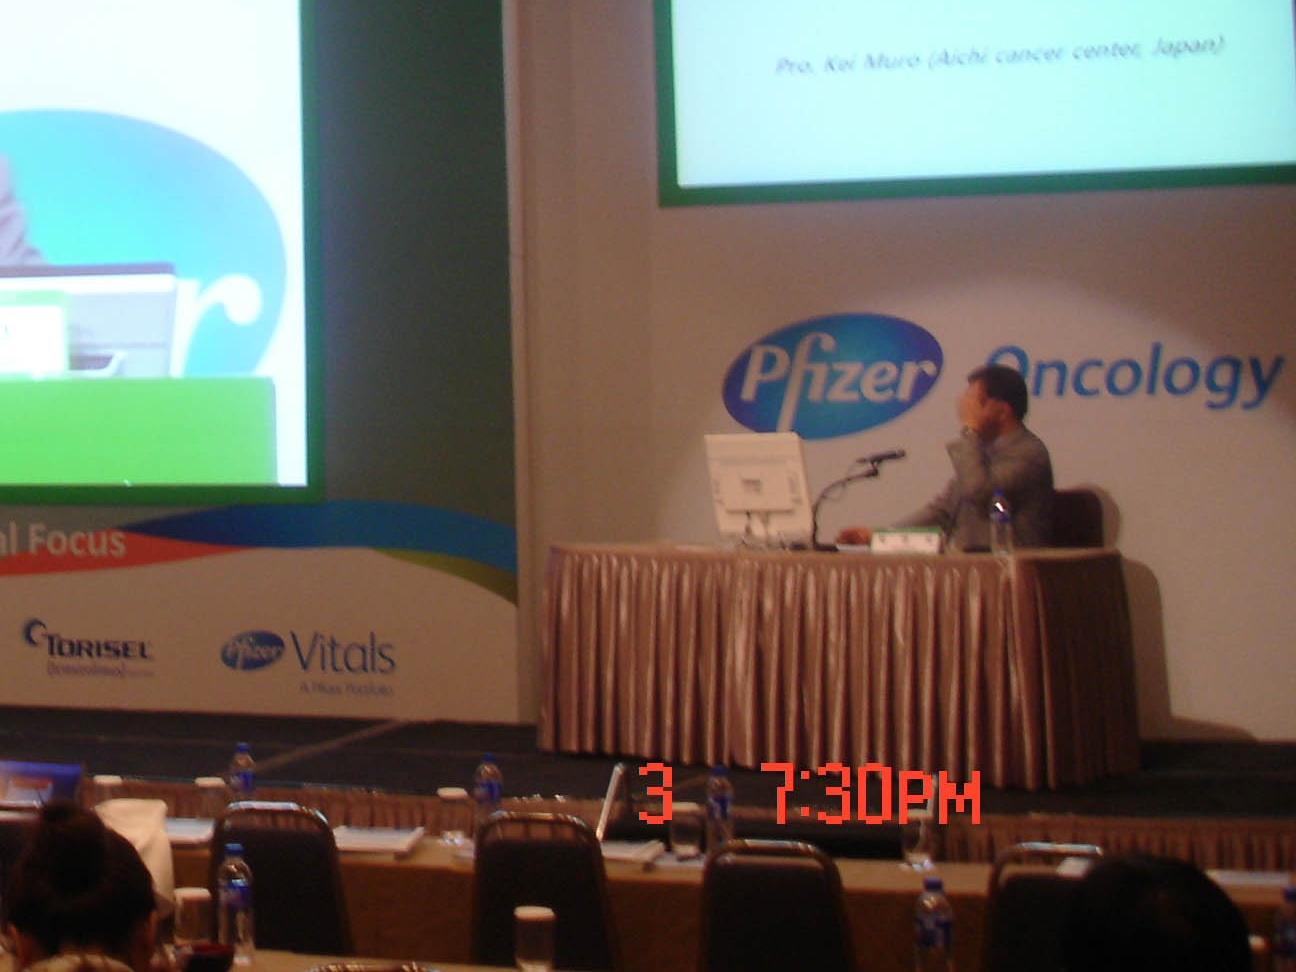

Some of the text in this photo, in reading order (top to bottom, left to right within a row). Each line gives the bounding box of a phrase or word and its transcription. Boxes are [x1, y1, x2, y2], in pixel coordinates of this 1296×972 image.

[823, 51, 855, 73] Kei
[862, 50, 921, 71] Muro
[994, 46, 1065, 66] cancer
[1150, 34, 1226, 61] Japan)
[740, 332, 938, 433] Pfizer
[29, 524, 126, 558] Focus
[289, 630, 397, 674] Vitals
